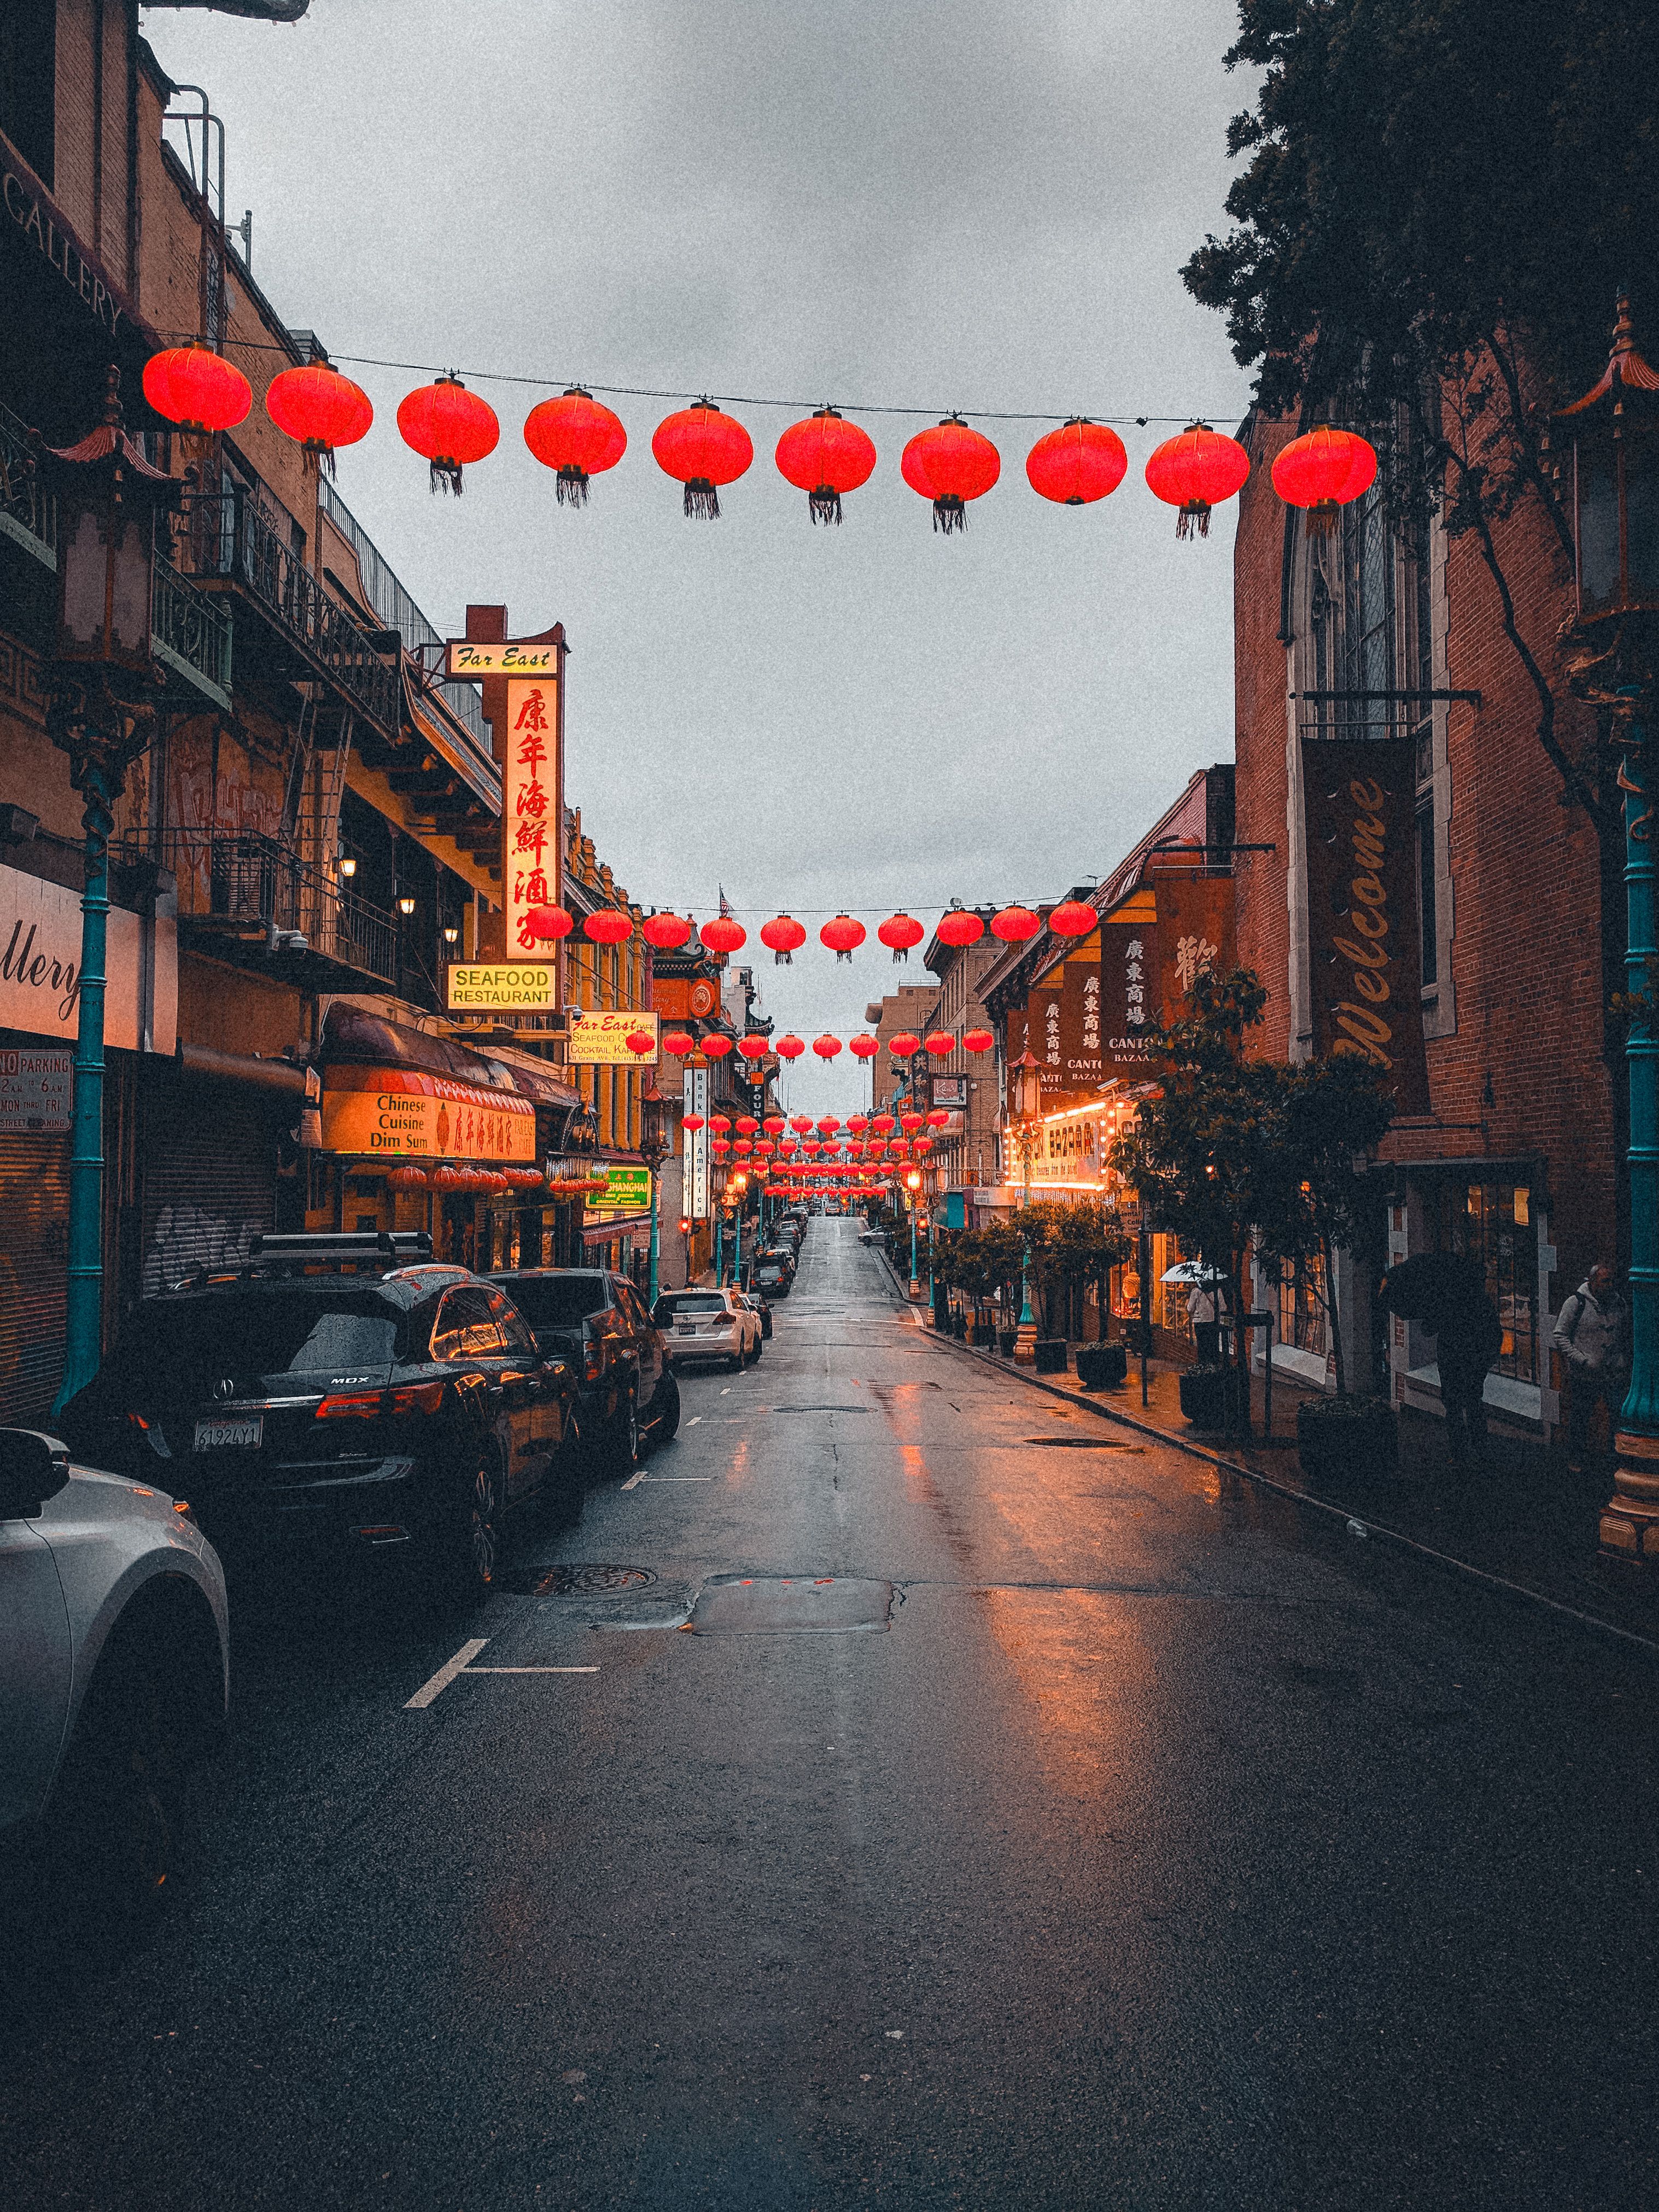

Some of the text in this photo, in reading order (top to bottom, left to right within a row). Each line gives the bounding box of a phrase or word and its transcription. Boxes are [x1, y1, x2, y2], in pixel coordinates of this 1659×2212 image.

[3, 173, 122, 337] GALLERY
[458, 647, 551, 667] Far East
[1333, 778, 1392, 1070] Welcome
[455, 970, 548, 986] SEAFOOD
[1125, 940, 1146, 1025] 廣東商場
[453, 990, 551, 1003] RESTAURANT
[1083, 976, 1100, 1049] 廣東商場
[573, 1014, 599, 1031] Far
[600, 1015, 637, 1031] East
[573, 1032, 615, 1042] SEAFOOD
[1045, 1003, 1061, 1066] 廣東商場
[571, 1044, 611, 1054] COCKTAIL
[21, 1058, 68, 1073] PARKING
[1067, 1059, 1102, 1070] CANT
[1, 1079, 9, 1093] 2
[41, 1078, 49, 1093] 6
[936, 1080, 956, 1095] Kan's
[1, 1099, 20, 1112] MON
[45, 1099, 60, 1111] FRI
[377, 1095, 425, 1112] Chinese
[753, 1085, 762, 1117] FOUR
[0, 1119, 26, 1127] STREET
[378, 1114, 424, 1130] Cuisine
[370, 1133, 428, 1149] Dim Sum
[607, 1182, 647, 1192] SHANGHAI
[330, 1377, 370, 1385] MDX
